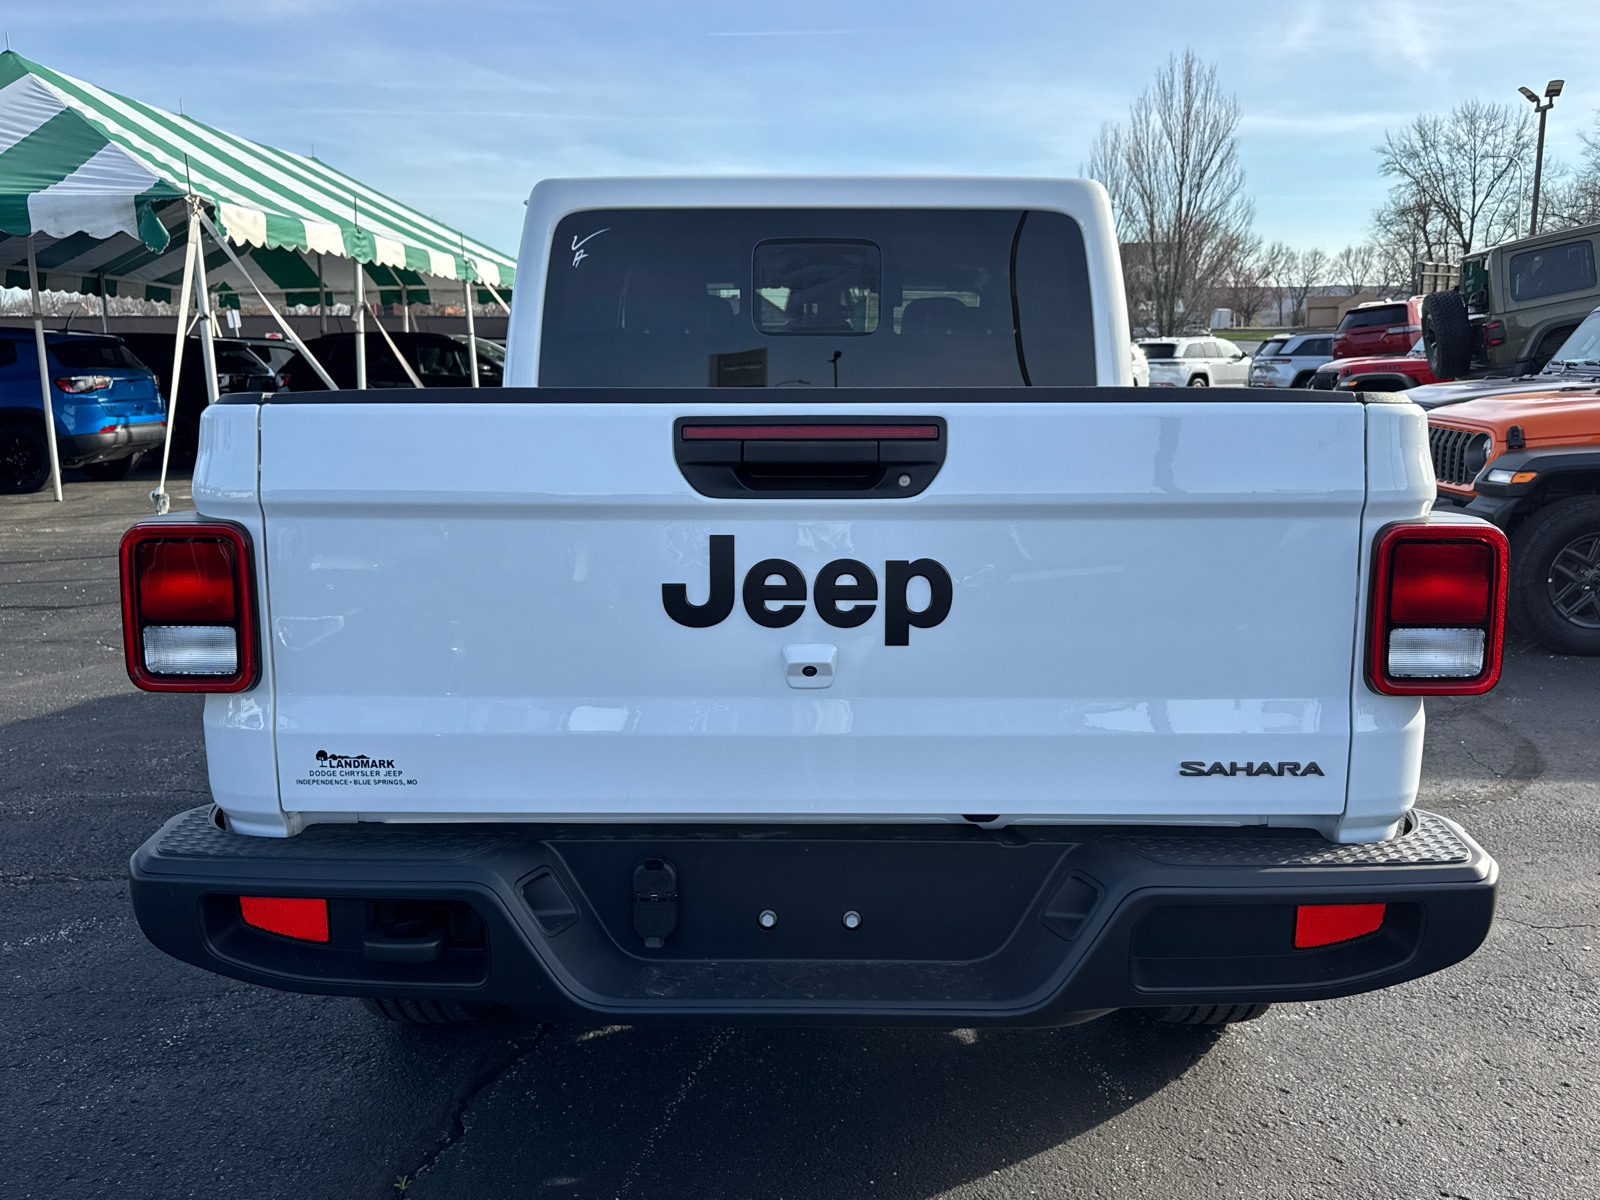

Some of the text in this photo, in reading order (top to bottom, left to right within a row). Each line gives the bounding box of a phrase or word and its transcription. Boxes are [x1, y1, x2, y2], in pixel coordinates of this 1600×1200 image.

[1372, 363, 1403, 371] WILLYS
[661, 534, 953, 646] Jeep
[328, 759, 395, 769] LANDMARK
[1179, 761, 1325, 777] SAHARA
